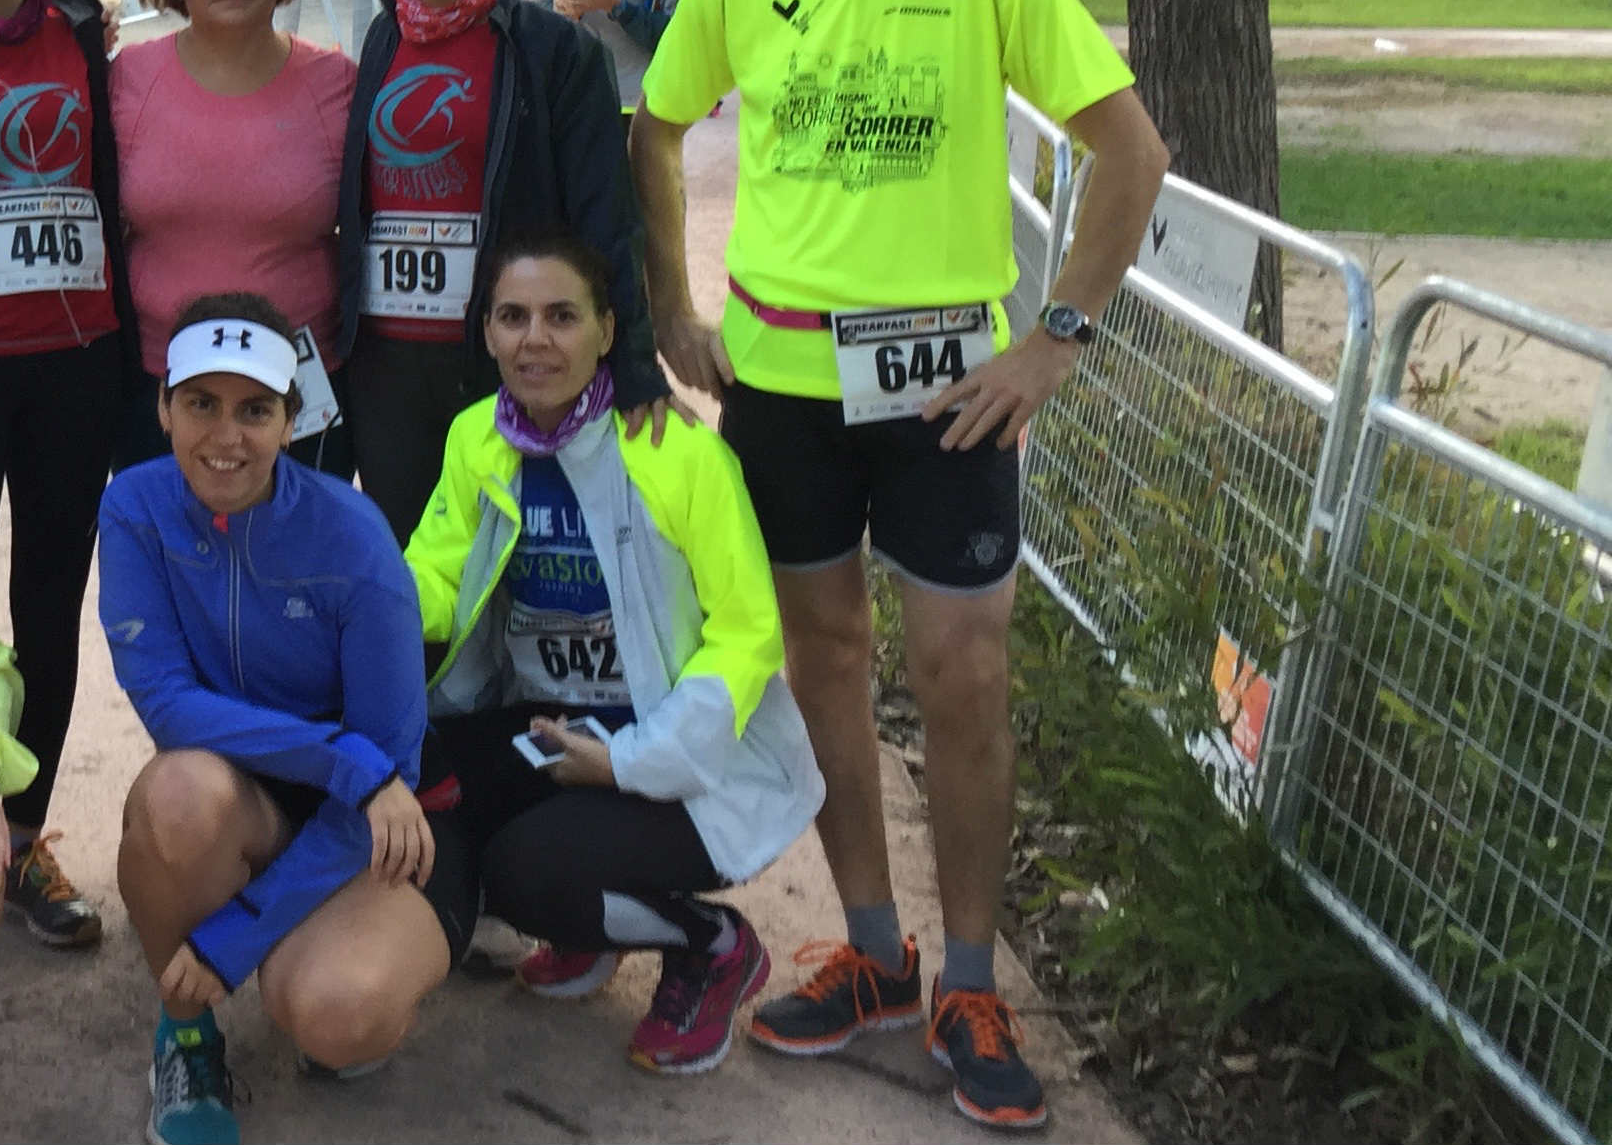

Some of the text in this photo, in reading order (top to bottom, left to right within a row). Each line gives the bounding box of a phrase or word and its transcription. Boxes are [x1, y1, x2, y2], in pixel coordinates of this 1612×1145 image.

[825, 138, 922, 153] EN VALENCIA
[844, 115, 934, 138] CORRER
[11, 224, 84, 267] 446
[379, 249, 446, 294] 199
[875, 339, 966, 392] 644
[537, 637, 624, 682] 642
